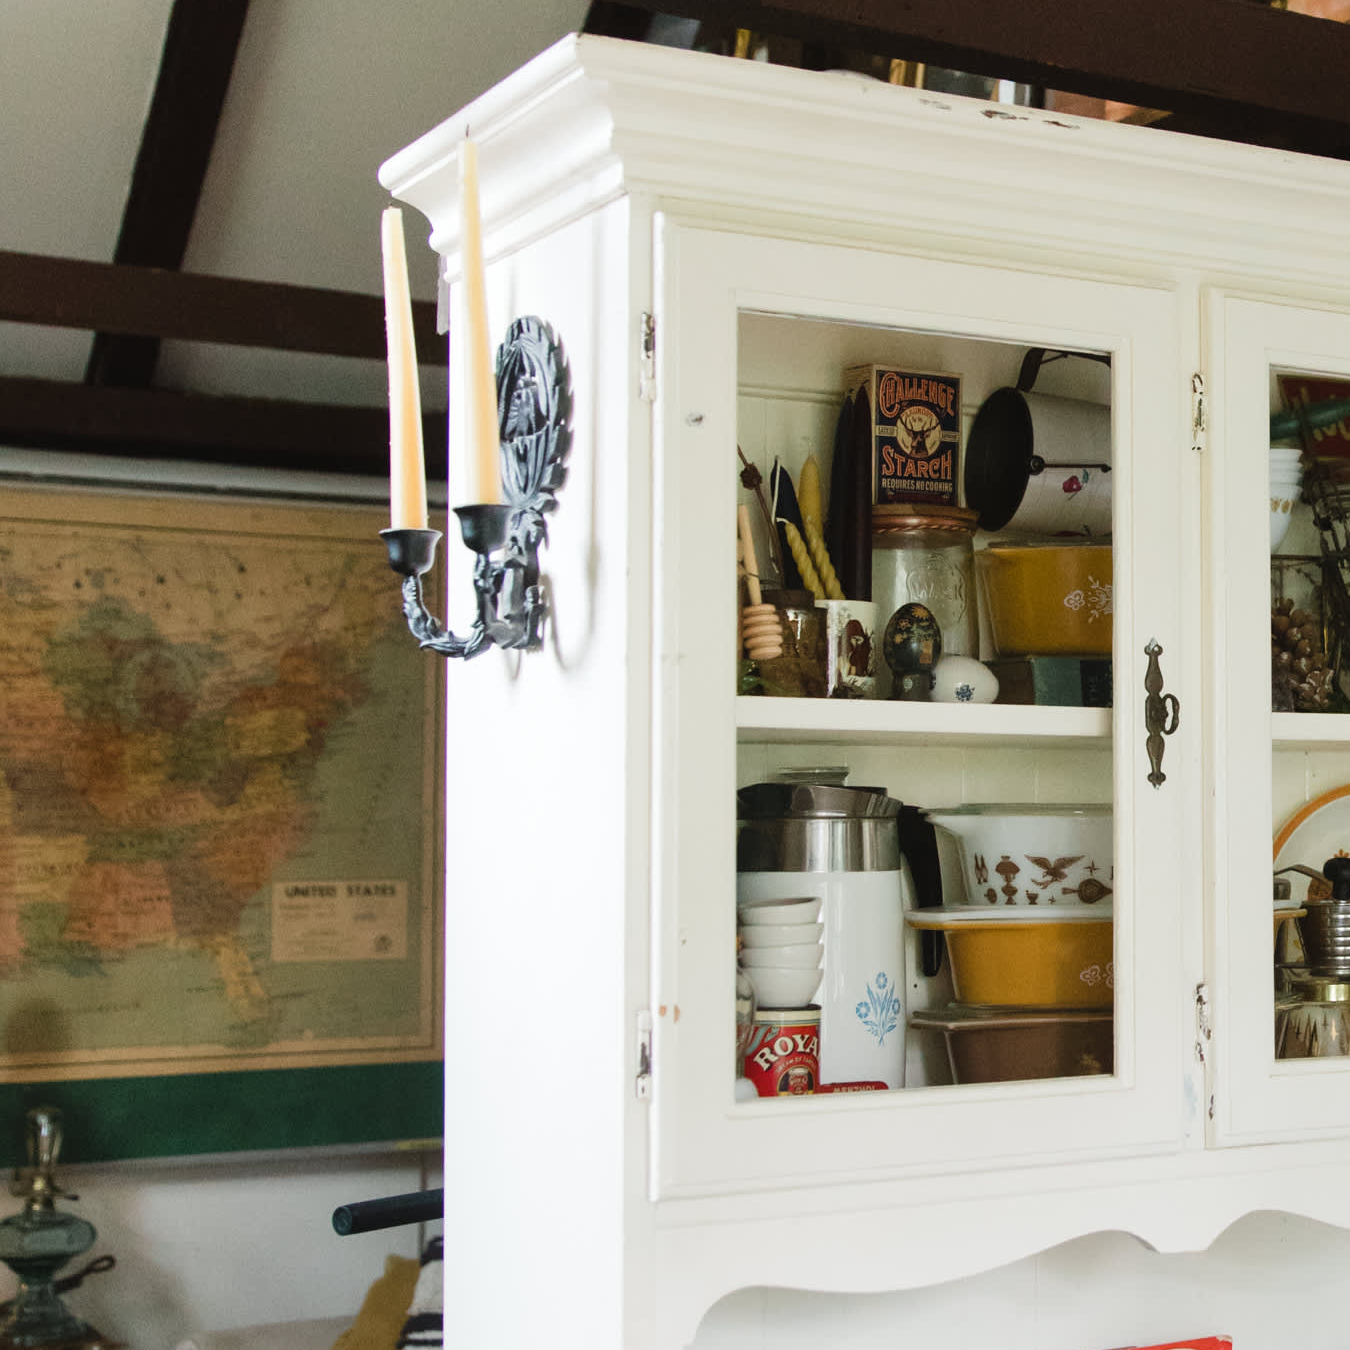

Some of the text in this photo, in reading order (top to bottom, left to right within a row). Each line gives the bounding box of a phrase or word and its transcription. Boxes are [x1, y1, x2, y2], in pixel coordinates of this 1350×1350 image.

[879, 372, 955, 418] CHALLENGE
[882, 445, 953, 480] STARCH
[882, 478, 953, 493] REQUIRES NO COOKING
[284, 884, 396, 899] UNITED STATES
[753, 1034, 819, 1071] ROYA
